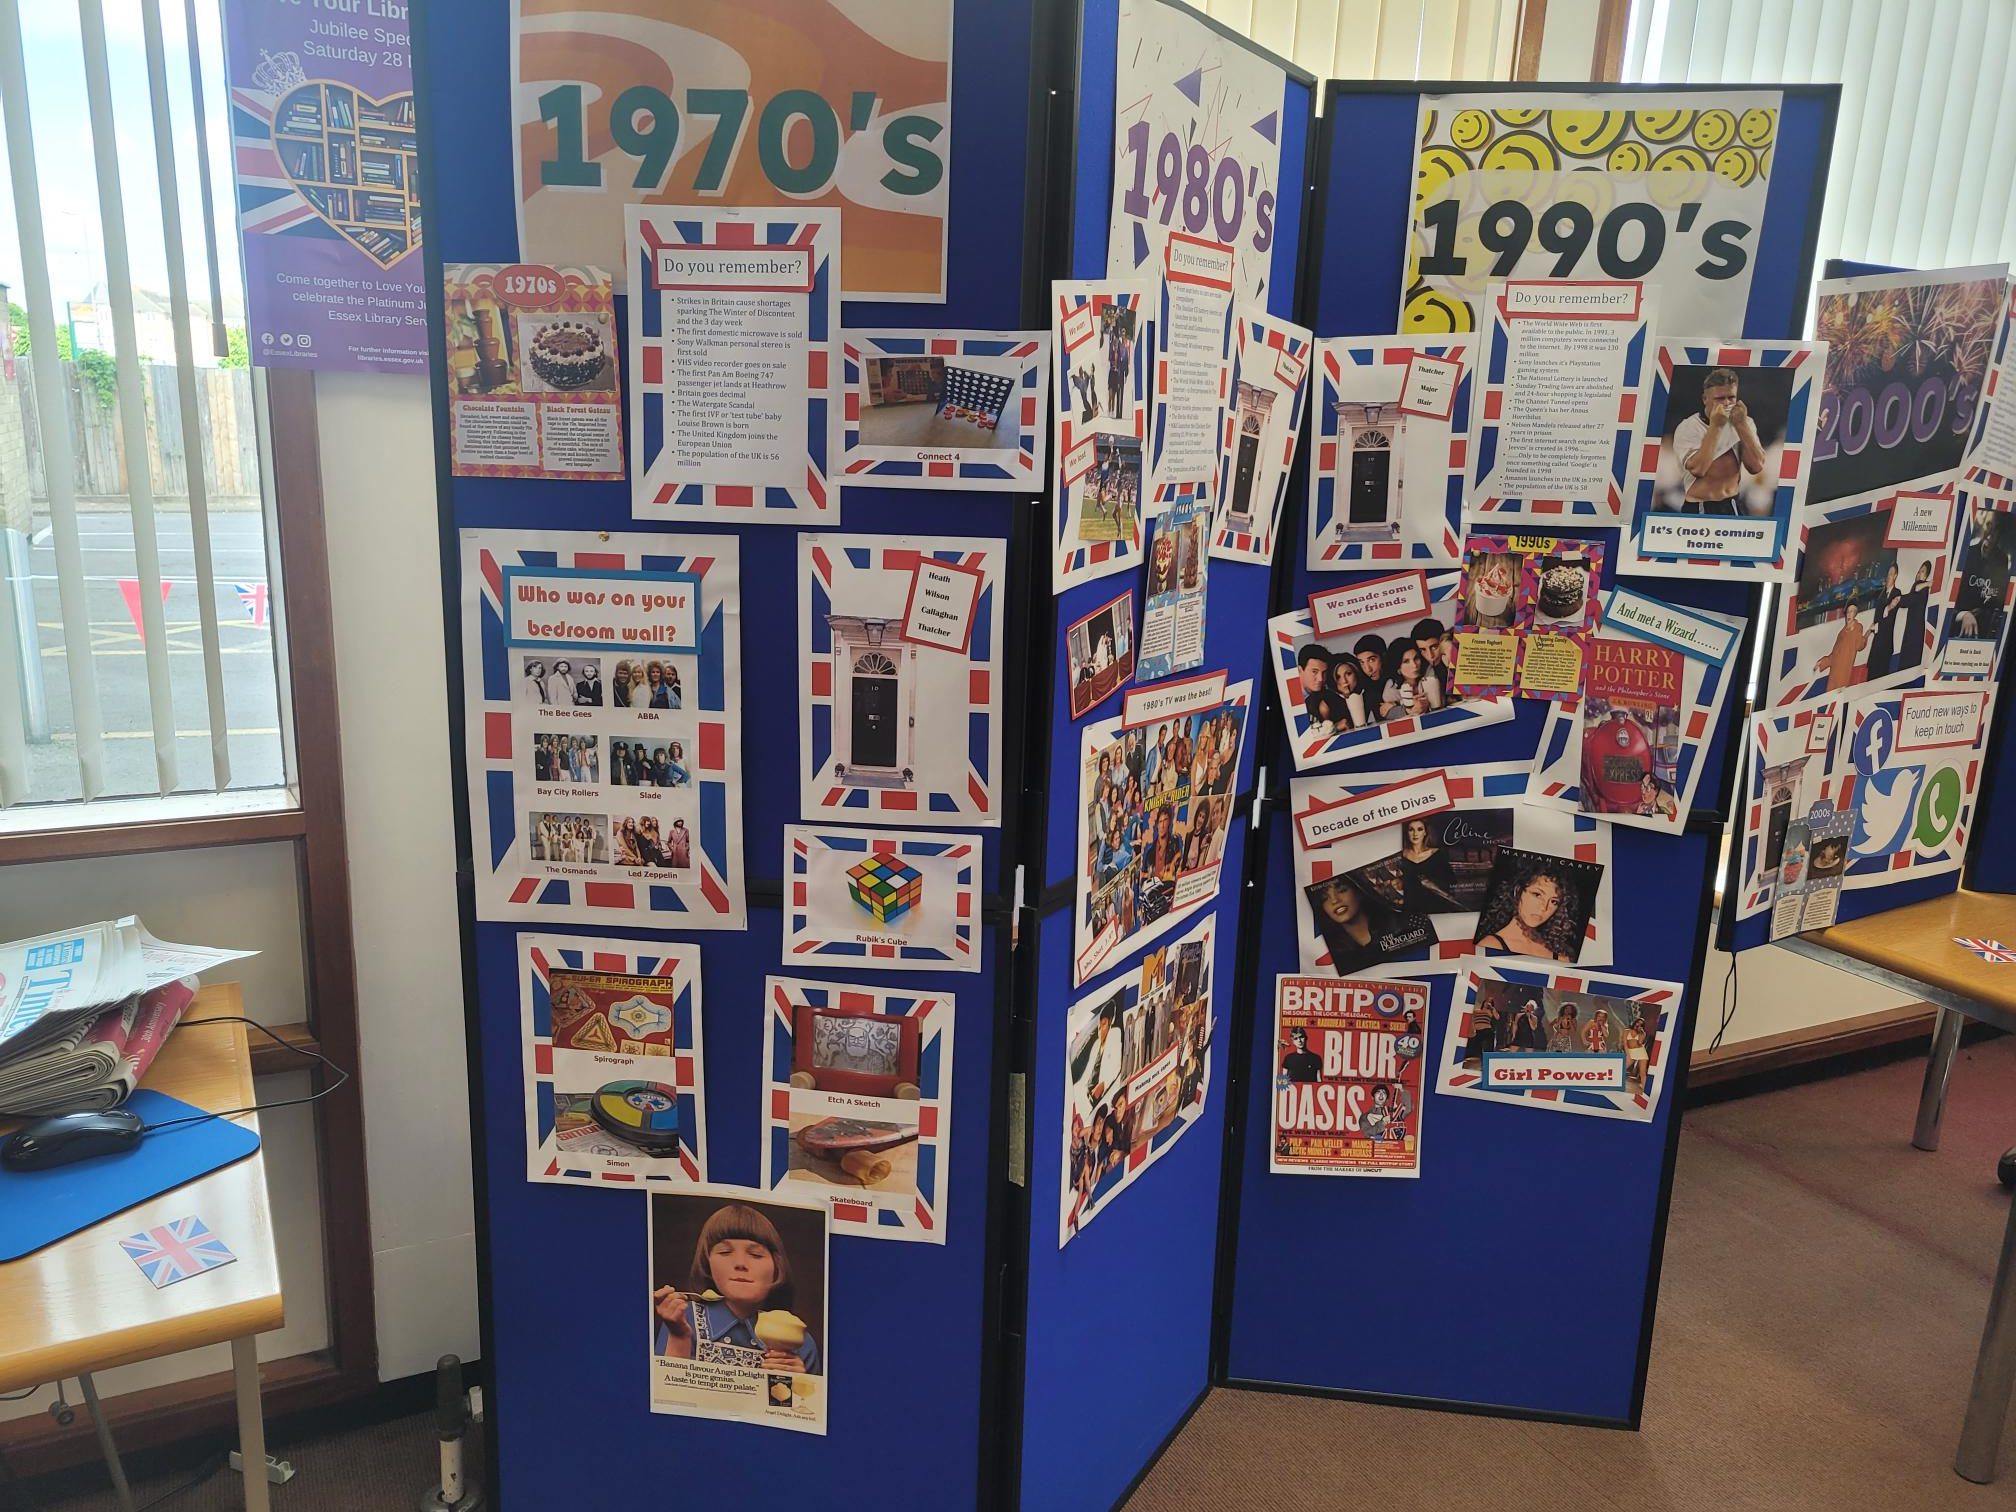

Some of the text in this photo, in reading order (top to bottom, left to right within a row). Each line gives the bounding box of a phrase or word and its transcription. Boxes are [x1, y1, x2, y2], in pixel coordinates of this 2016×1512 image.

[368, 0, 408, 20] Libr
[310, 20, 368, 40] Jubilee
[304, 41, 402, 67] Saturday 28
[538, 85, 944, 195] 1970's
[1124, 120, 1274, 253] 1980's
[1418, 200, 1753, 280] 1990's
[664, 258, 801, 276] Do you remember?
[1174, 249, 1228, 272] Do you remember?
[277, 273, 311, 285] Come
[313, 276, 359, 289] together
[362, 280, 372, 289] to
[376, 281, 401, 291] Love
[505, 276, 557, 293] 1970s
[293, 291, 414, 309] celebrate the Platinum
[711, 298, 734, 306] Britain
[757, 299, 791, 308] shortages
[1515, 292, 1628, 306] Do you remember?
[328, 311, 401, 327] Essex Library
[677, 339, 693, 347] Sony
[729, 340, 759, 349] personal
[1418, 366, 1445, 375] Thatcher
[917, 452, 950, 460] Connect
[1914, 506, 1932, 517] A new
[1651, 526, 1764, 539] It's (not) coming
[1902, 521, 1938, 532] Millennium
[1515, 536, 1550, 549] 1990s
[1687, 540, 1723, 548] home
[928, 572, 950, 583] Heath
[518, 585, 685, 612] Who was on your
[925, 589, 949, 601] Wilson
[1326, 584, 1414, 609] We made some
[921, 606, 958, 621] Callaghan
[1338, 597, 1406, 618] new friends
[1617, 602, 1638, 621] And
[1637, 613, 1653, 625] met
[1655, 619, 1662, 629] a
[528, 620, 676, 642] bedroom wall?
[918, 623, 950, 637] Thatcher
[1596, 644, 1674, 668] HARRY
[1593, 665, 1675, 690] POTTER
[1143, 699, 1164, 712] 1980's
[1165, 698, 1174, 708] TV
[1175, 696, 1186, 706] was
[1187, 691, 1198, 702] the
[1654, 691, 1670, 699] Stone
[1906, 705, 1977, 720] Found new ways to
[1914, 723, 1964, 738] keep in touch
[537, 788, 552, 797] Bay
[554, 789, 569, 797] City
[1312, 793, 1436, 836] Decade of the Divas
[1810, 808, 1830, 820] 2000s
[1502, 849, 1600, 872] MARIAH CAREY
[644, 871, 677, 879] Zeppelin
[856, 934, 908, 946] Rubik's Cube
[606, 978, 673, 986] SPIROGRAPH
[1282, 986, 1424, 1015] BRITPOP
[594, 1055, 634, 1065] Spirograph
[1324, 1030, 1396, 1078] BLUR
[1494, 1069, 1613, 1080] Girl Power!
[828, 1096, 880, 1108] Etch A Sketch
[1279, 1084, 1365, 1131] OASIS
[830, 1196, 873, 1206] Skateboard
[690, 1364, 714, 1374] flavour
[716, 1367, 736, 1376] Angel
[738, 1369, 764, 1379] Delight
[692, 1372, 709, 1380] pure
[710, 1374, 735, 1382] genius.
[697, 1380, 718, 1388] tempt
[719, 1382, 732, 1390] any
